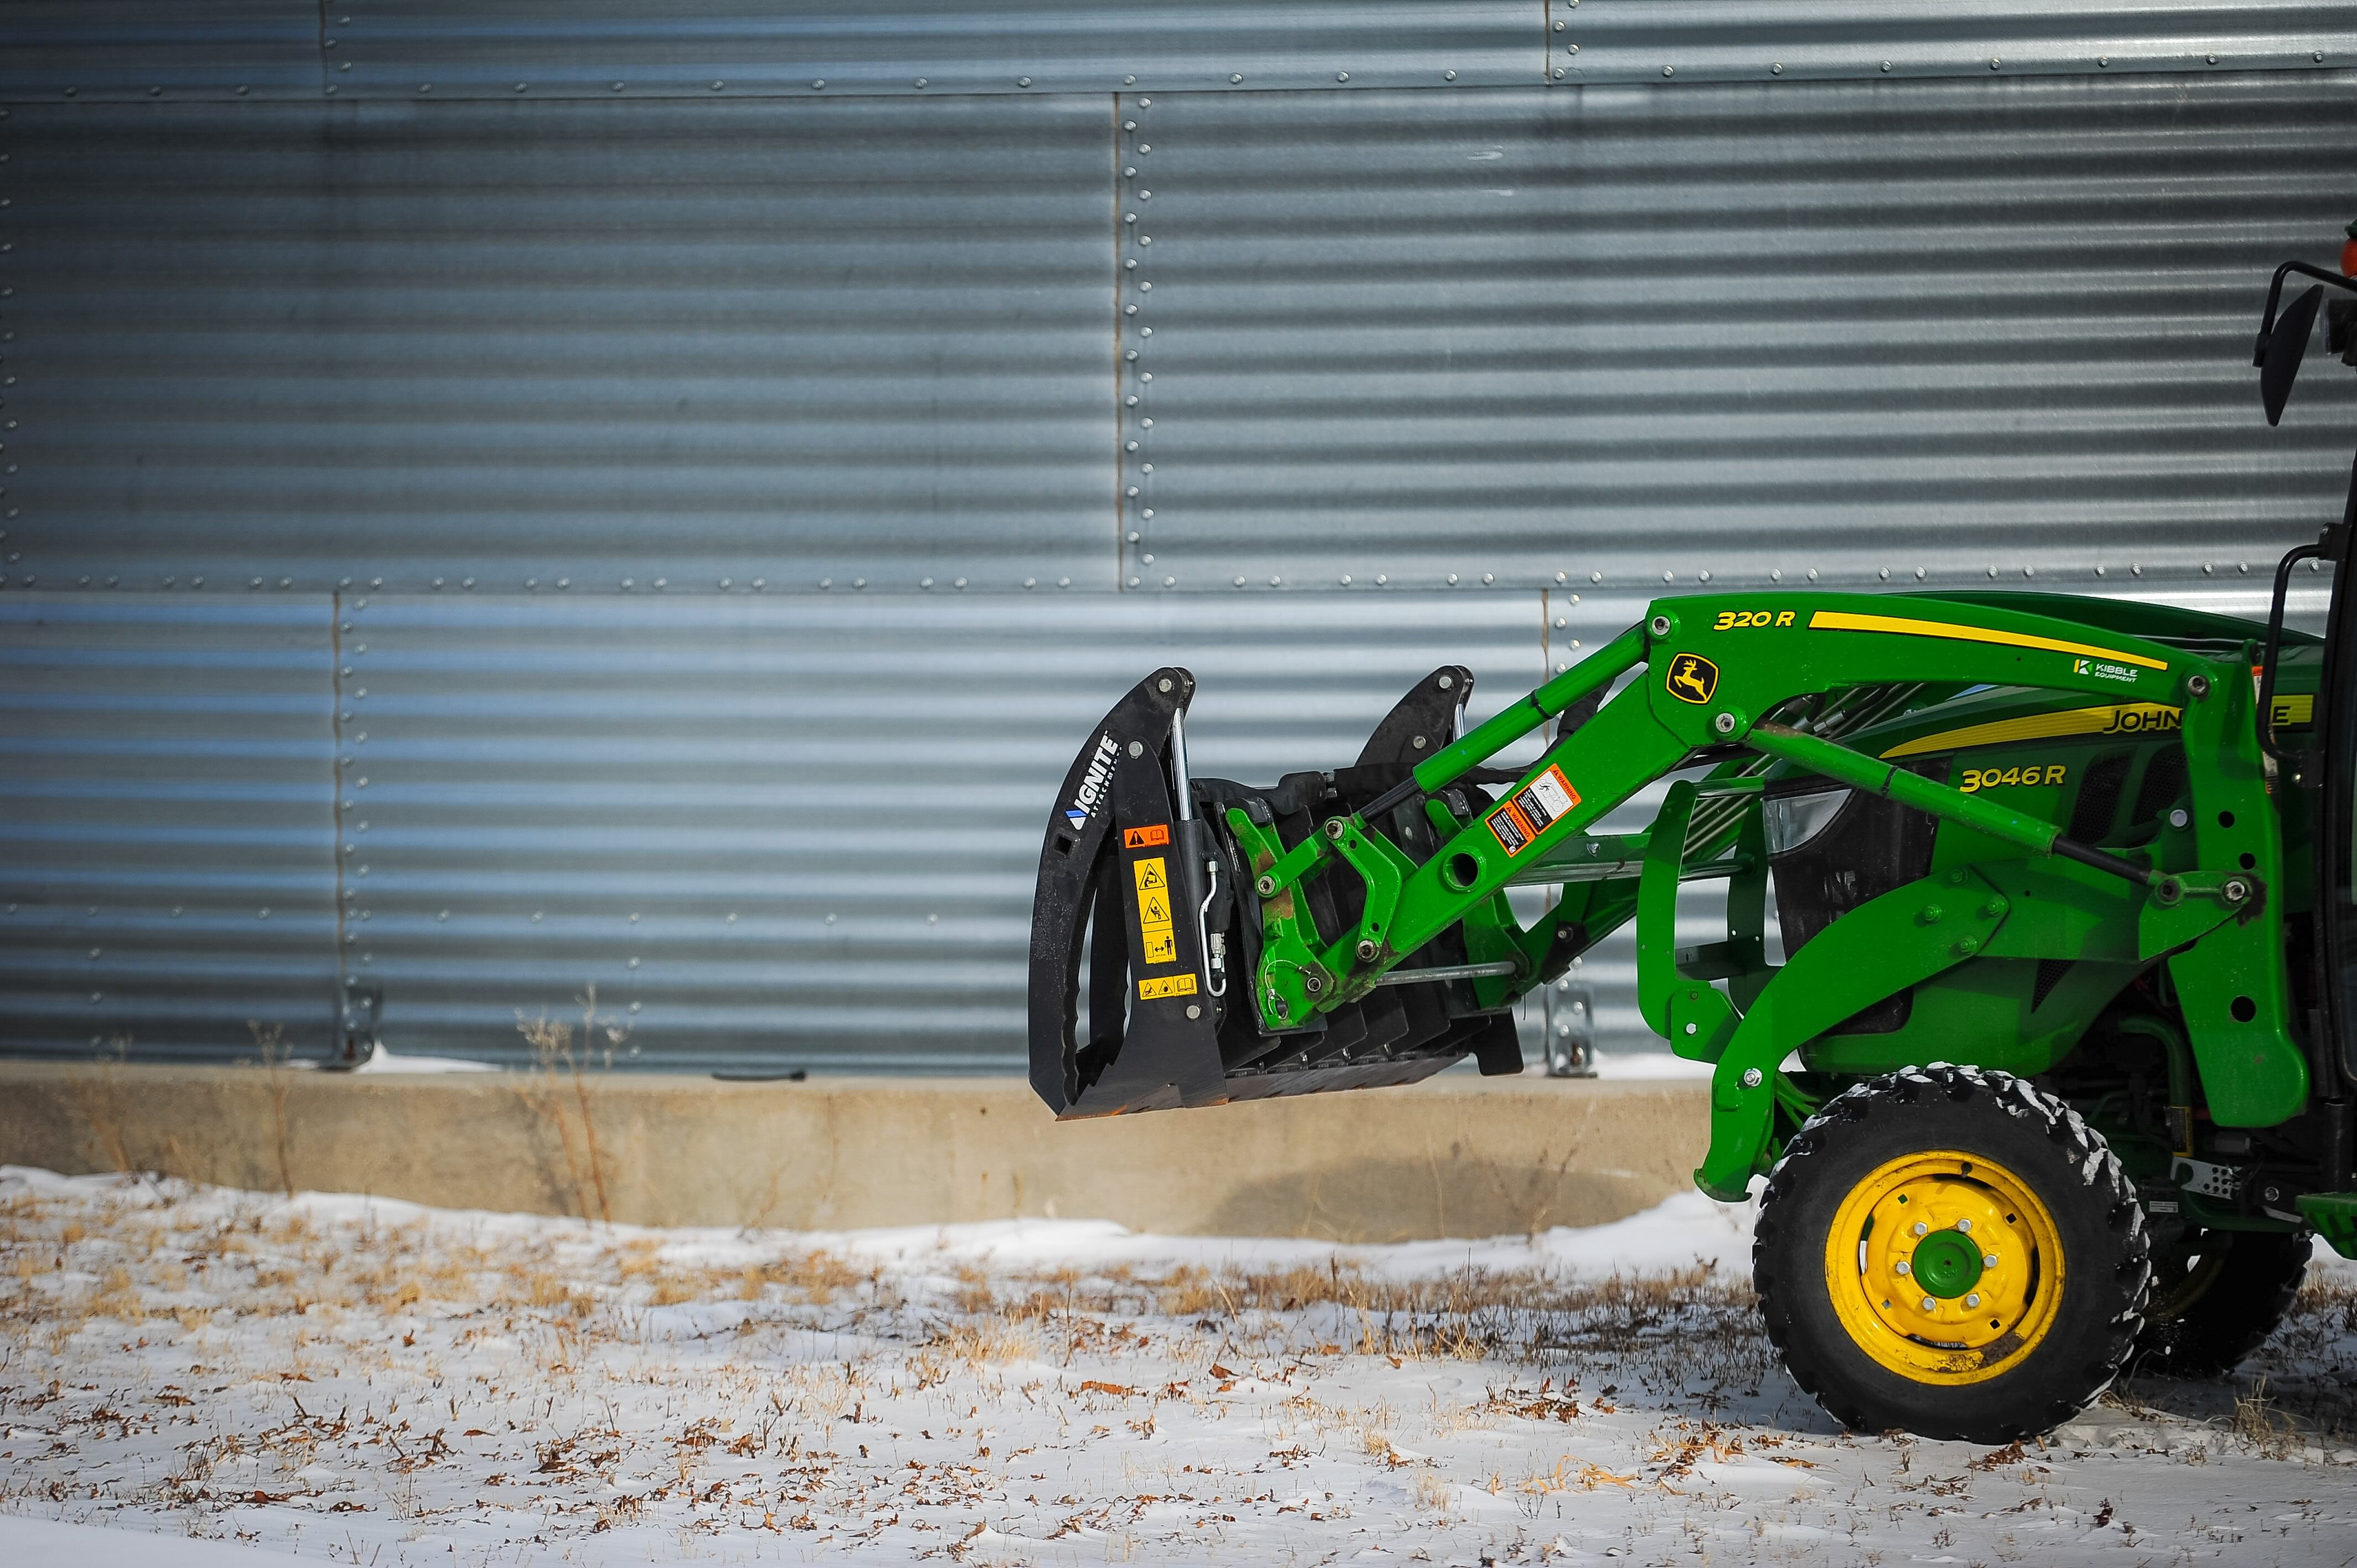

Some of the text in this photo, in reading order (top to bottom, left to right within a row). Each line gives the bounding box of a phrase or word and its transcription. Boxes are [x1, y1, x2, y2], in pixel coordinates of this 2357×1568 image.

[1713, 611, 1772, 631] 320
[2095, 663, 2138, 677] KIBBLE
[2103, 709, 2183, 731] JOHN
[1073, 735, 1118, 814] IGNITE
[1557, 775, 1576, 800] WARNING
[1511, 812, 1530, 838] WARNING
